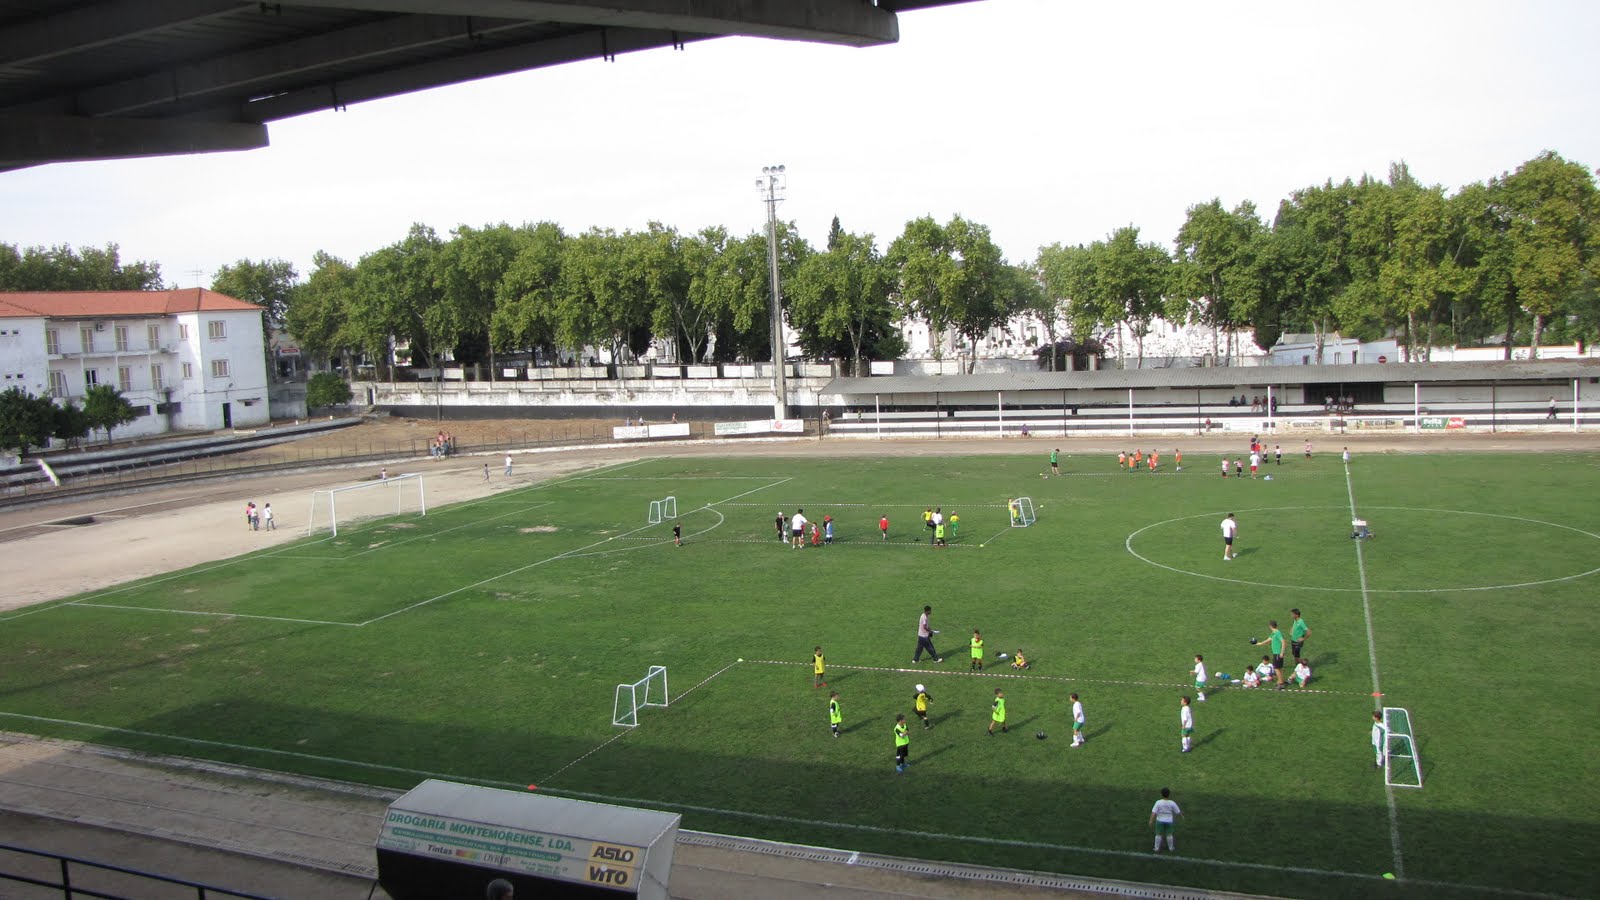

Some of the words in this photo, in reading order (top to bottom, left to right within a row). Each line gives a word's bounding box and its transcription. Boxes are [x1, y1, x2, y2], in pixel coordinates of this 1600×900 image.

[388, 812, 447, 830] DROGARIA
[449, 822, 545, 849] MONTEMORENSE,
[548, 838, 576, 852] LDA.
[427, 844, 453, 855] Tintas
[592, 845, 634, 863] ASLO
